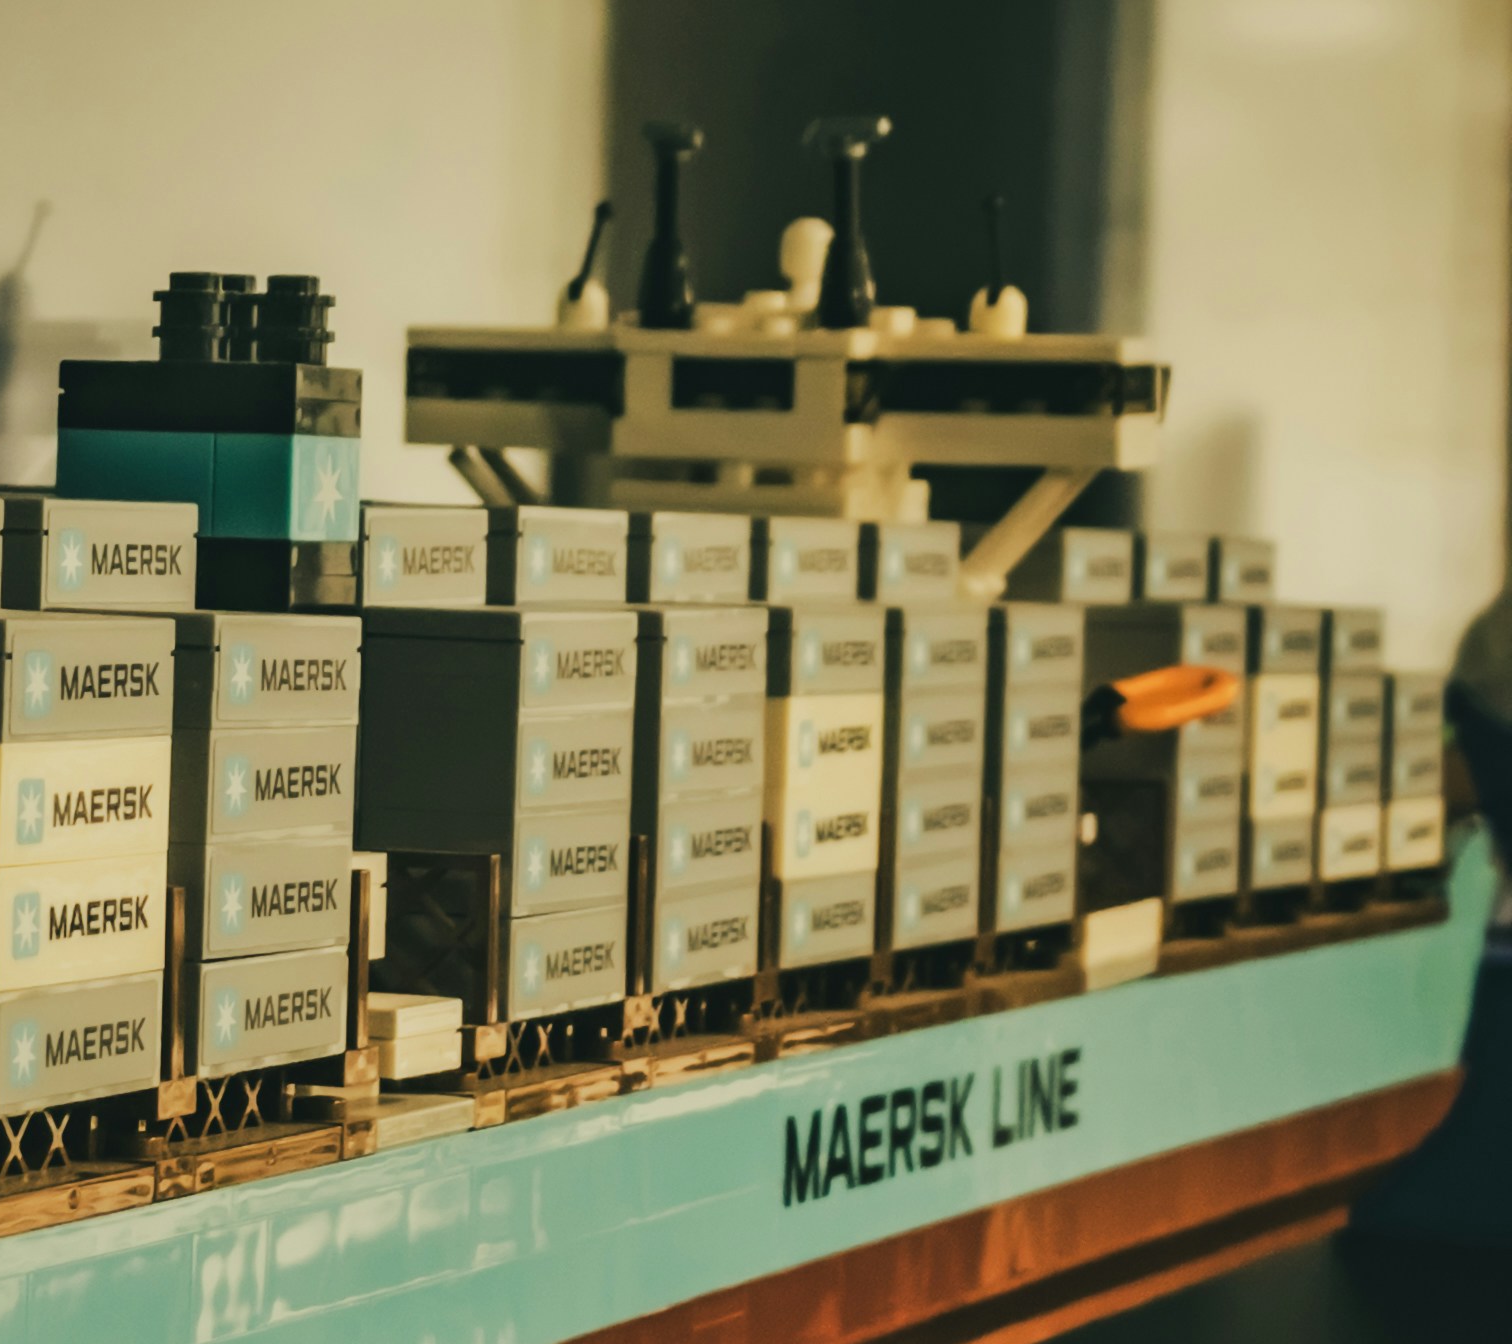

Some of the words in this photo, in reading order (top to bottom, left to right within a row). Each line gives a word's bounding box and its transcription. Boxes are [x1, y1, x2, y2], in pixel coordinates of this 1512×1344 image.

[91, 543, 182, 576] MAERSK
[402, 545, 474, 576] MAERSK
[260, 658, 347, 692] MAERSK
[556, 648, 625, 680] MAERSK
[695, 643, 756, 672] MAERSK
[60, 662, 160, 701] MAERSK
[552, 748, 621, 779] MAERSK
[692, 738, 753, 767] MAERSK
[255, 763, 341, 802] MAERSK
[52, 784, 153, 828] MAERSK
[549, 844, 618, 877] MAERSK
[690, 826, 752, 860] MAERSK
[251, 878, 338, 919] MAERSK
[48, 895, 148, 941] MAERSK
[687, 916, 748, 953] MAERSK
[545, 942, 615, 980] MAERSK
[244, 986, 332, 1031] MAERSK
[45, 1017, 146, 1068] MAERSK
[782, 1071, 976, 1208] MAERSK
[992, 1047, 1083, 1149] LINE
